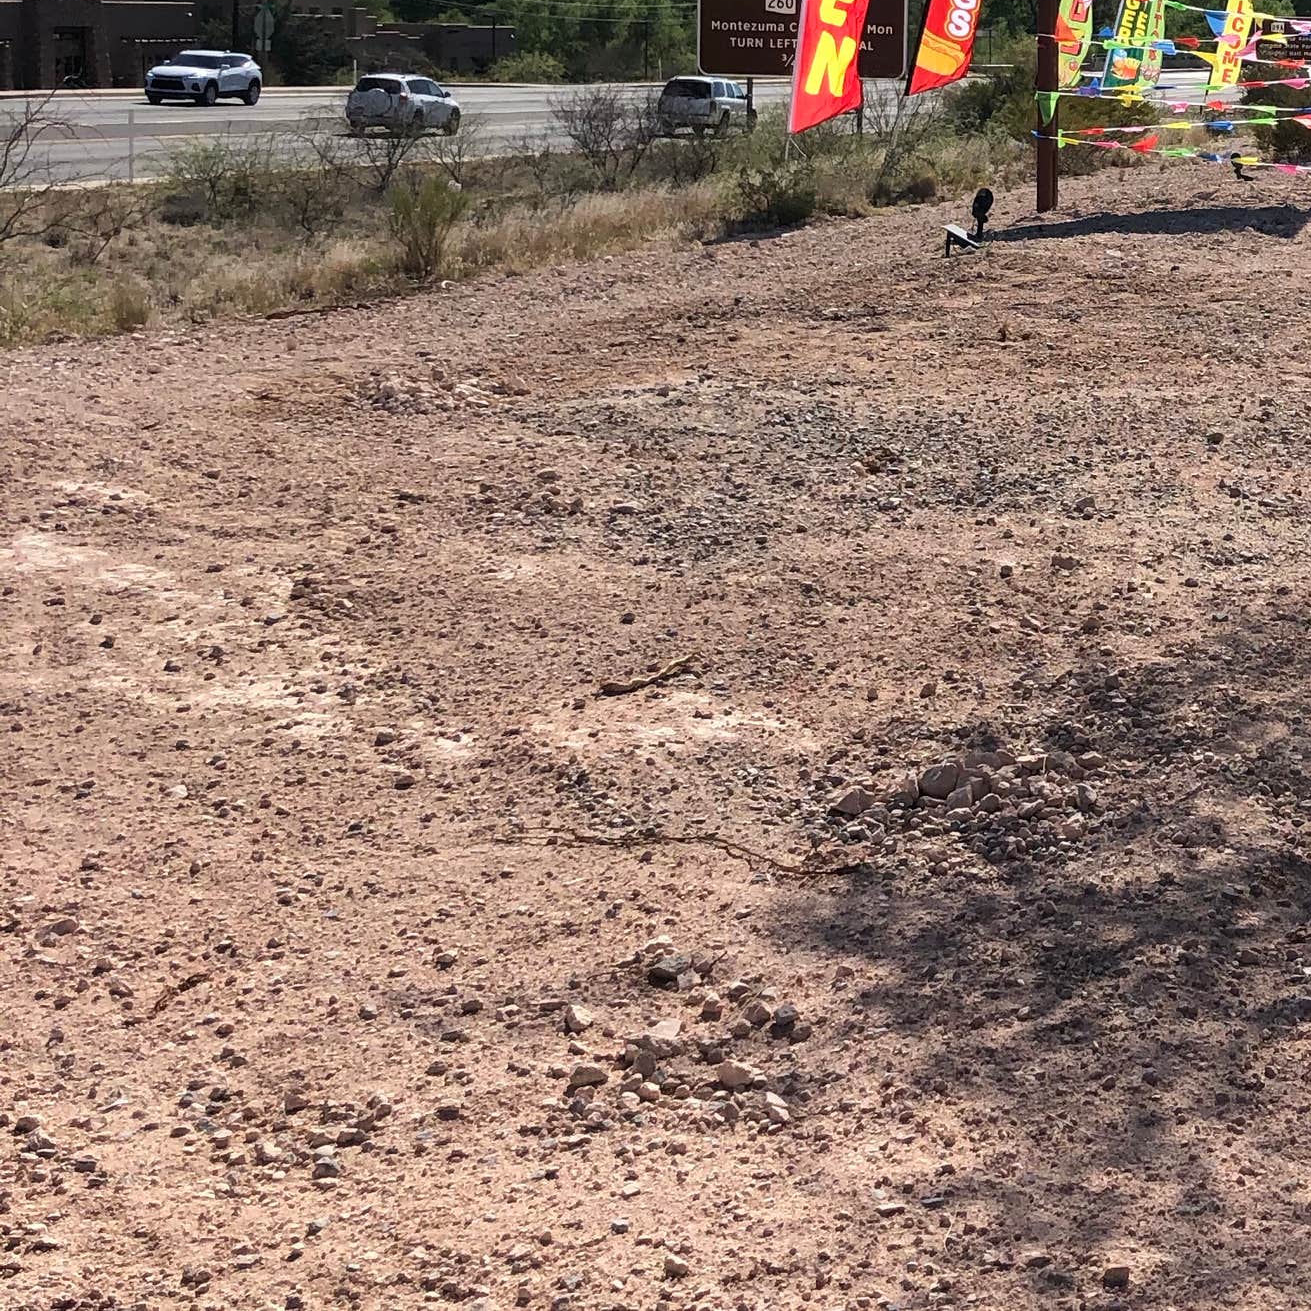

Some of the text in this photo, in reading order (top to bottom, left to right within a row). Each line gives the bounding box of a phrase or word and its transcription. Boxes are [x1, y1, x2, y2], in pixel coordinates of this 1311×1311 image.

[711, 20, 785, 33] Montezuma
[866, 24, 894, 36] Mon
[730, 37, 798, 49] TURN LEFT
